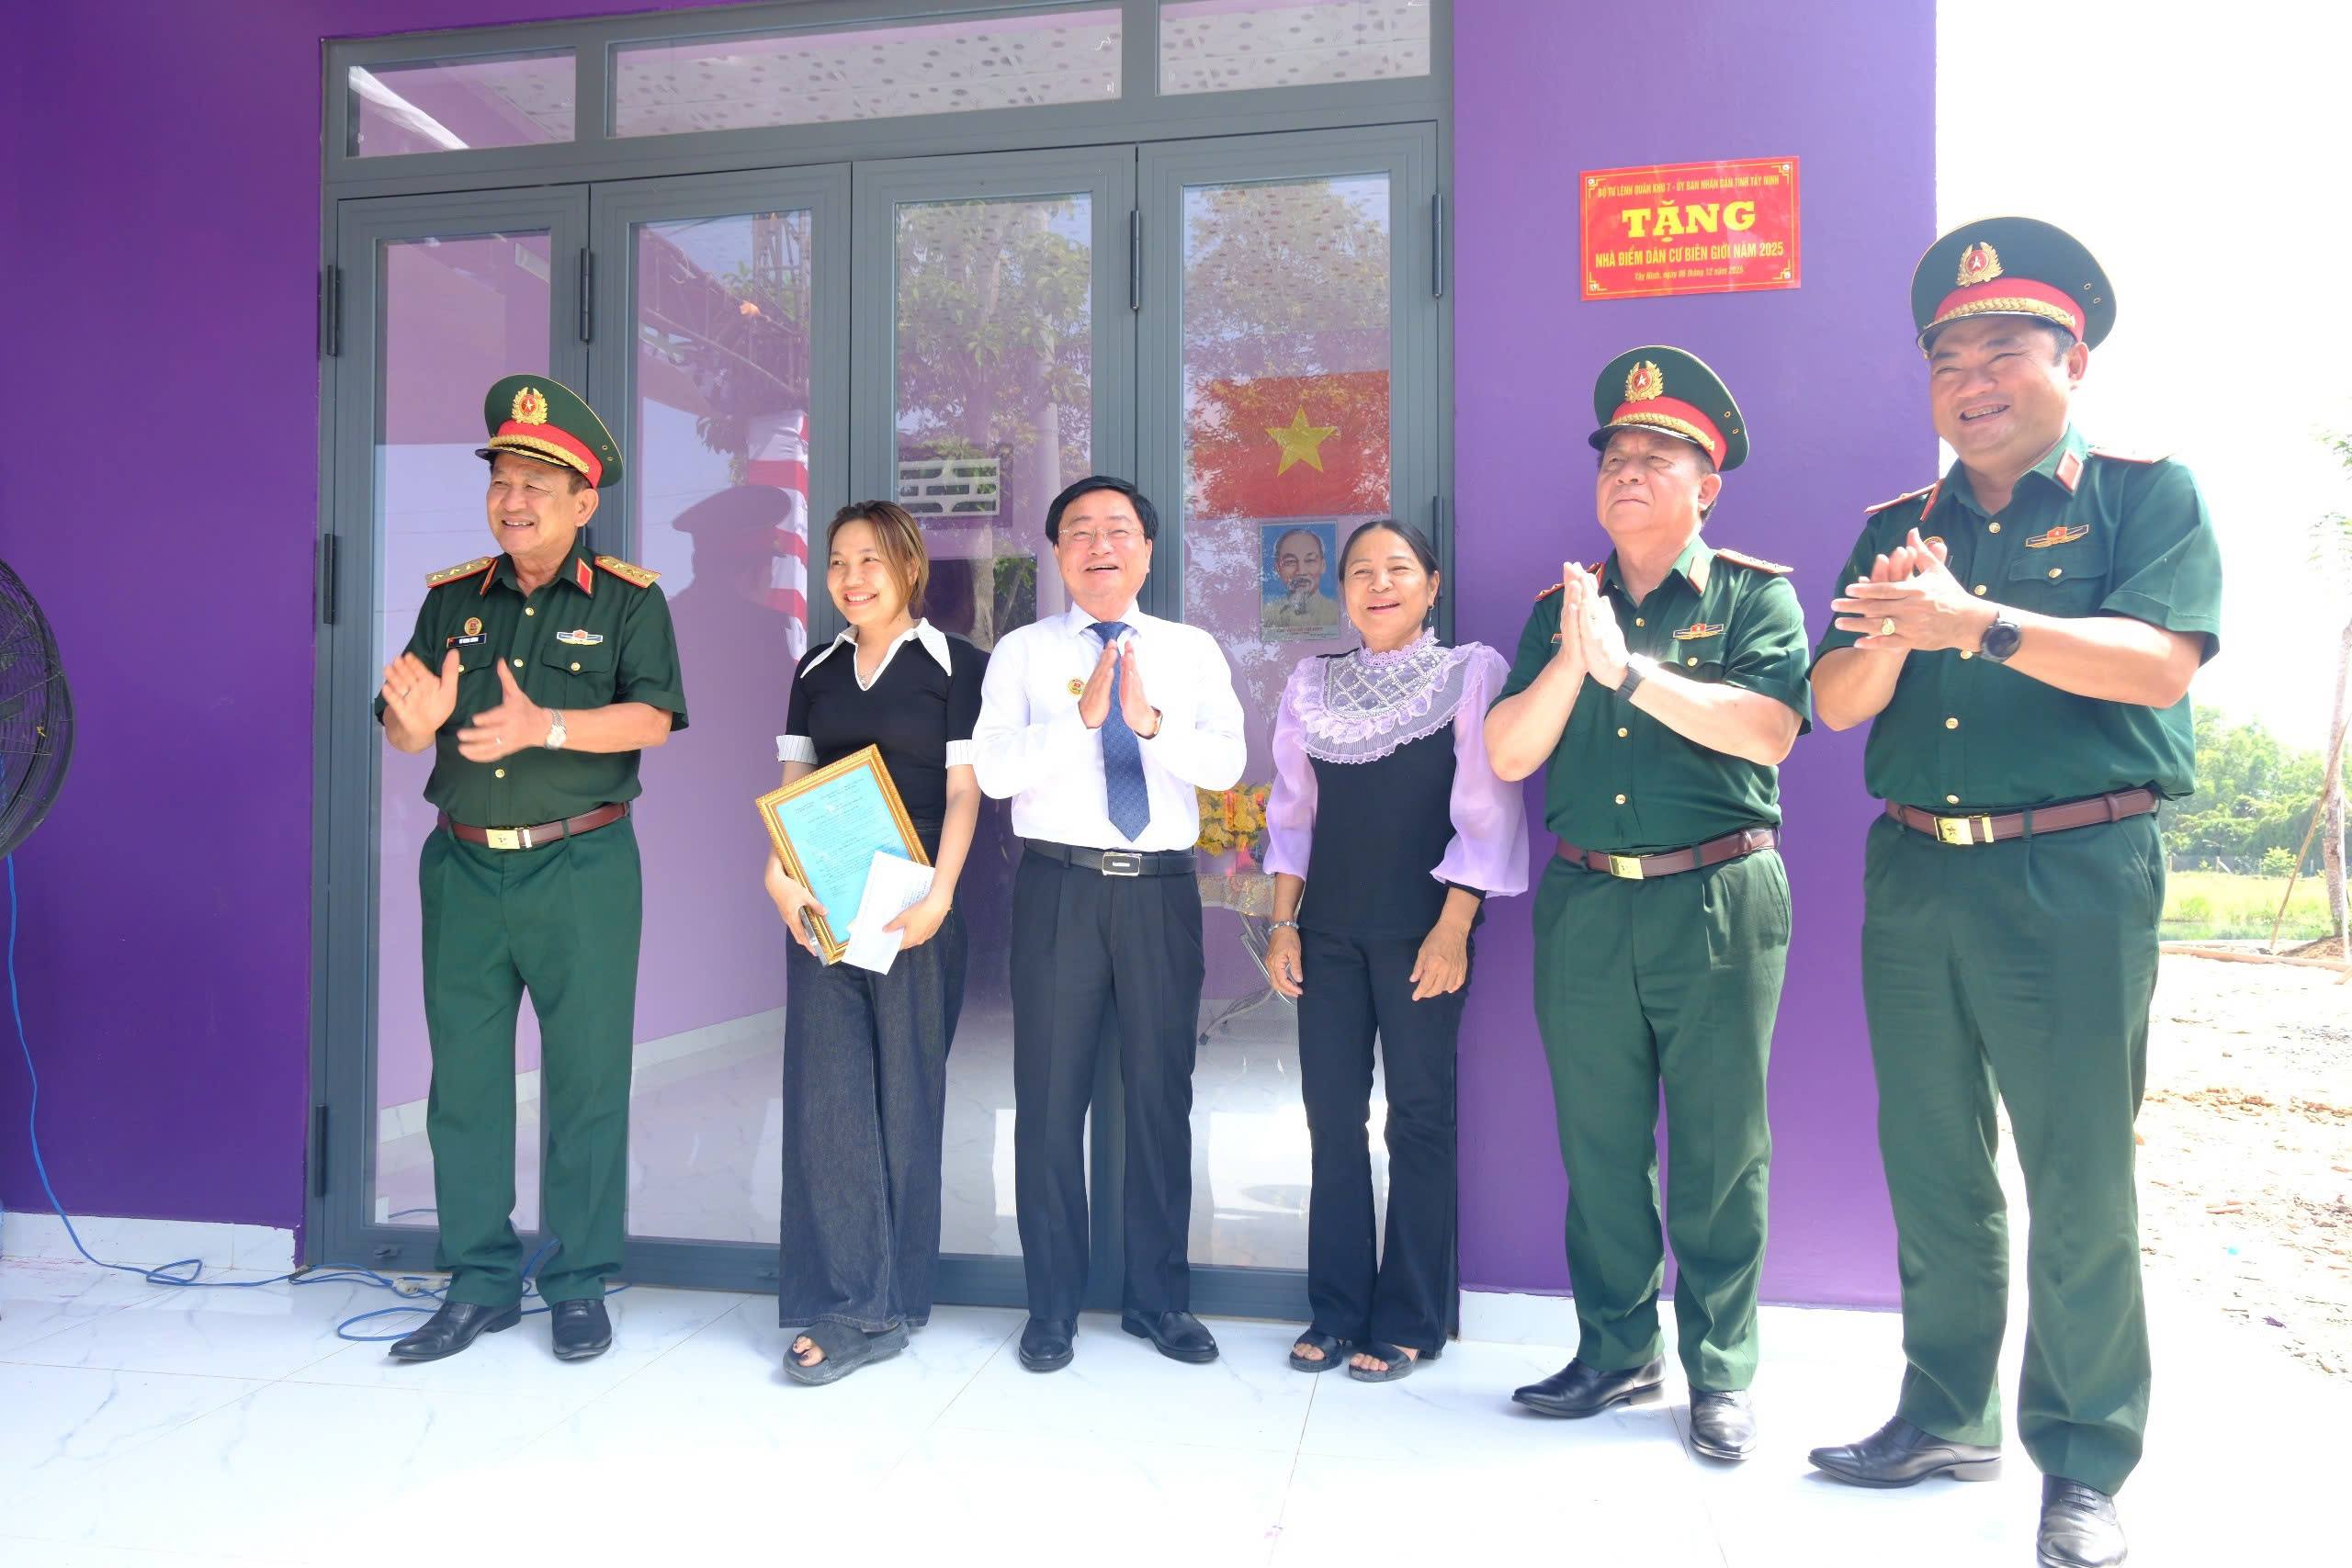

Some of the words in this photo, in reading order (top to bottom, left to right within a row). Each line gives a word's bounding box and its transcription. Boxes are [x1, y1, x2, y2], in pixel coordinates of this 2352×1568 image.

[1653, 183, 1665, 195] KHU
[1666, 183, 1671, 192] 7
[1687, 180, 1699, 190] BAN
[1764, 175, 1780, 185] NINH
[1622, 199, 1756, 243] TẶNG
[1595, 250, 1615, 268] NHÀ
[1618, 244, 1643, 266] ĐIỂM
[1645, 246, 1666, 265] DÂN
[1669, 246, 1684, 263] CƯ
[1685, 243, 1708, 262] BIÊN
[1711, 242, 1732, 260] GIỚI
[1733, 241, 1757, 258] NĂM
[1760, 241, 1784, 257] 2025
